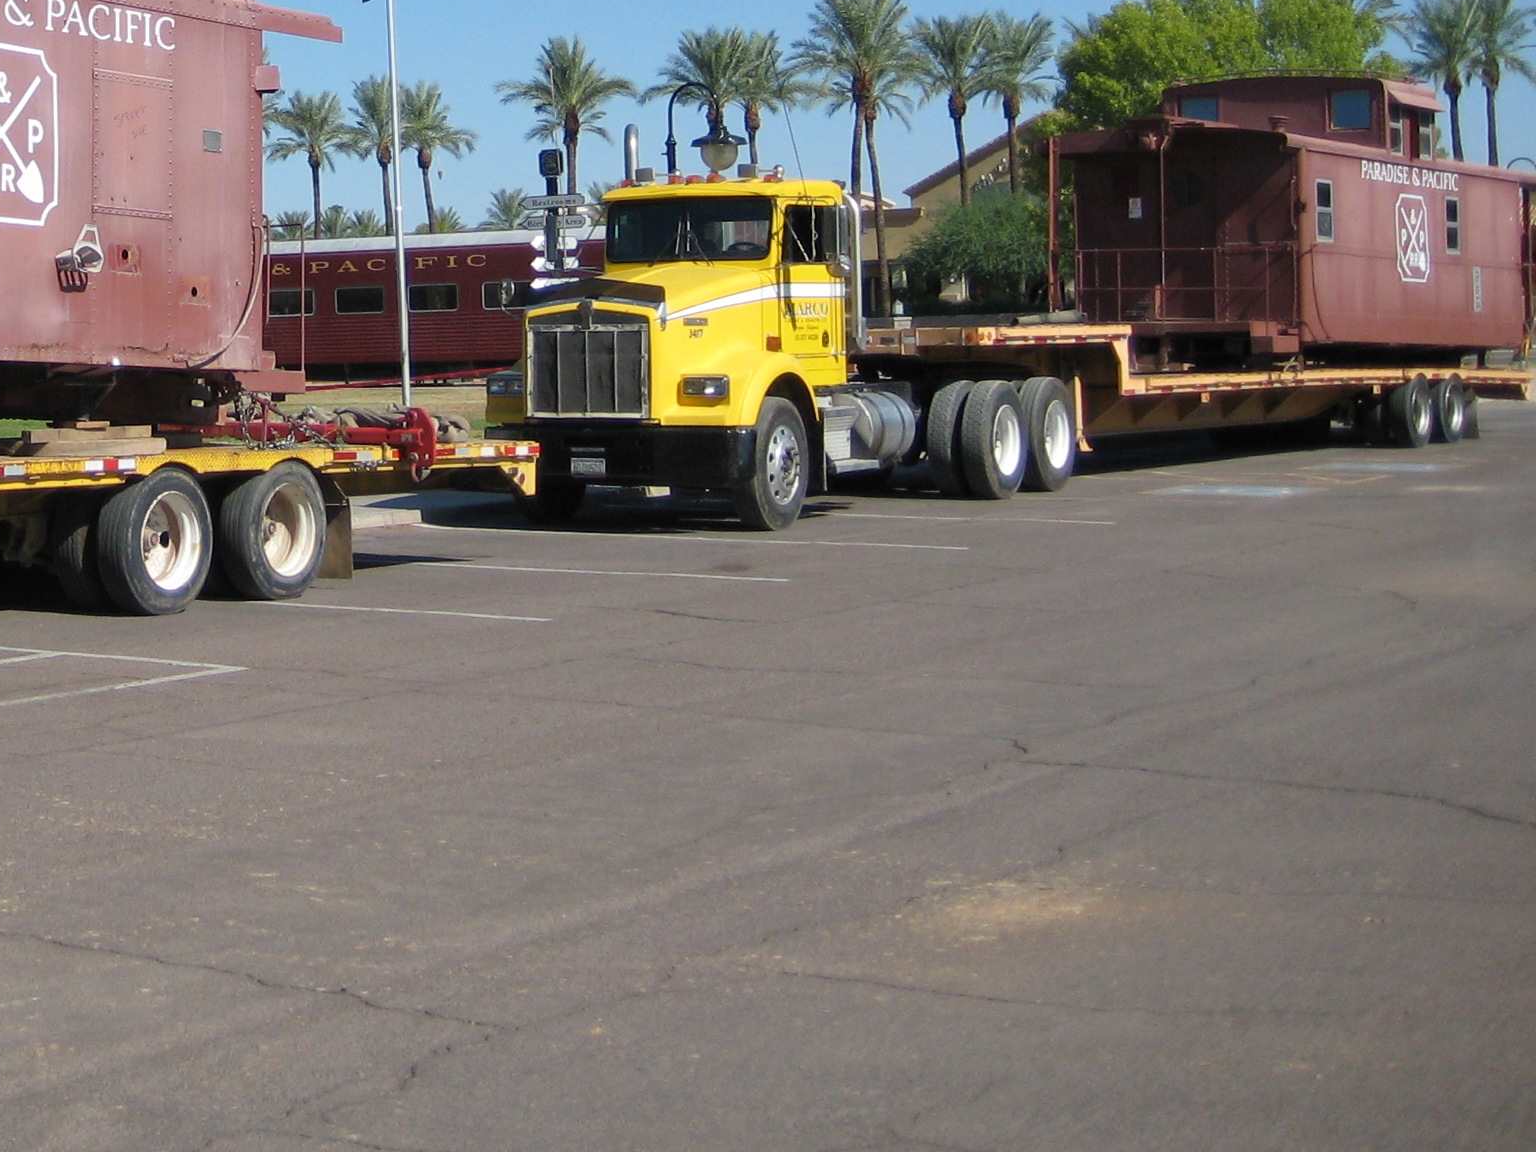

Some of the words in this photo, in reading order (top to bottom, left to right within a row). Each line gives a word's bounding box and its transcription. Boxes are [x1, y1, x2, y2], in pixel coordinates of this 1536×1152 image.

[28, 118, 44, 153] P
[1361, 160, 1409, 184] PARADISE
[1411, 167, 1421, 186] &
[1422, 170, 1459, 191] PACIFIC
[271, 263, 291, 275] &
[309, 254, 488, 274] PACFIC
